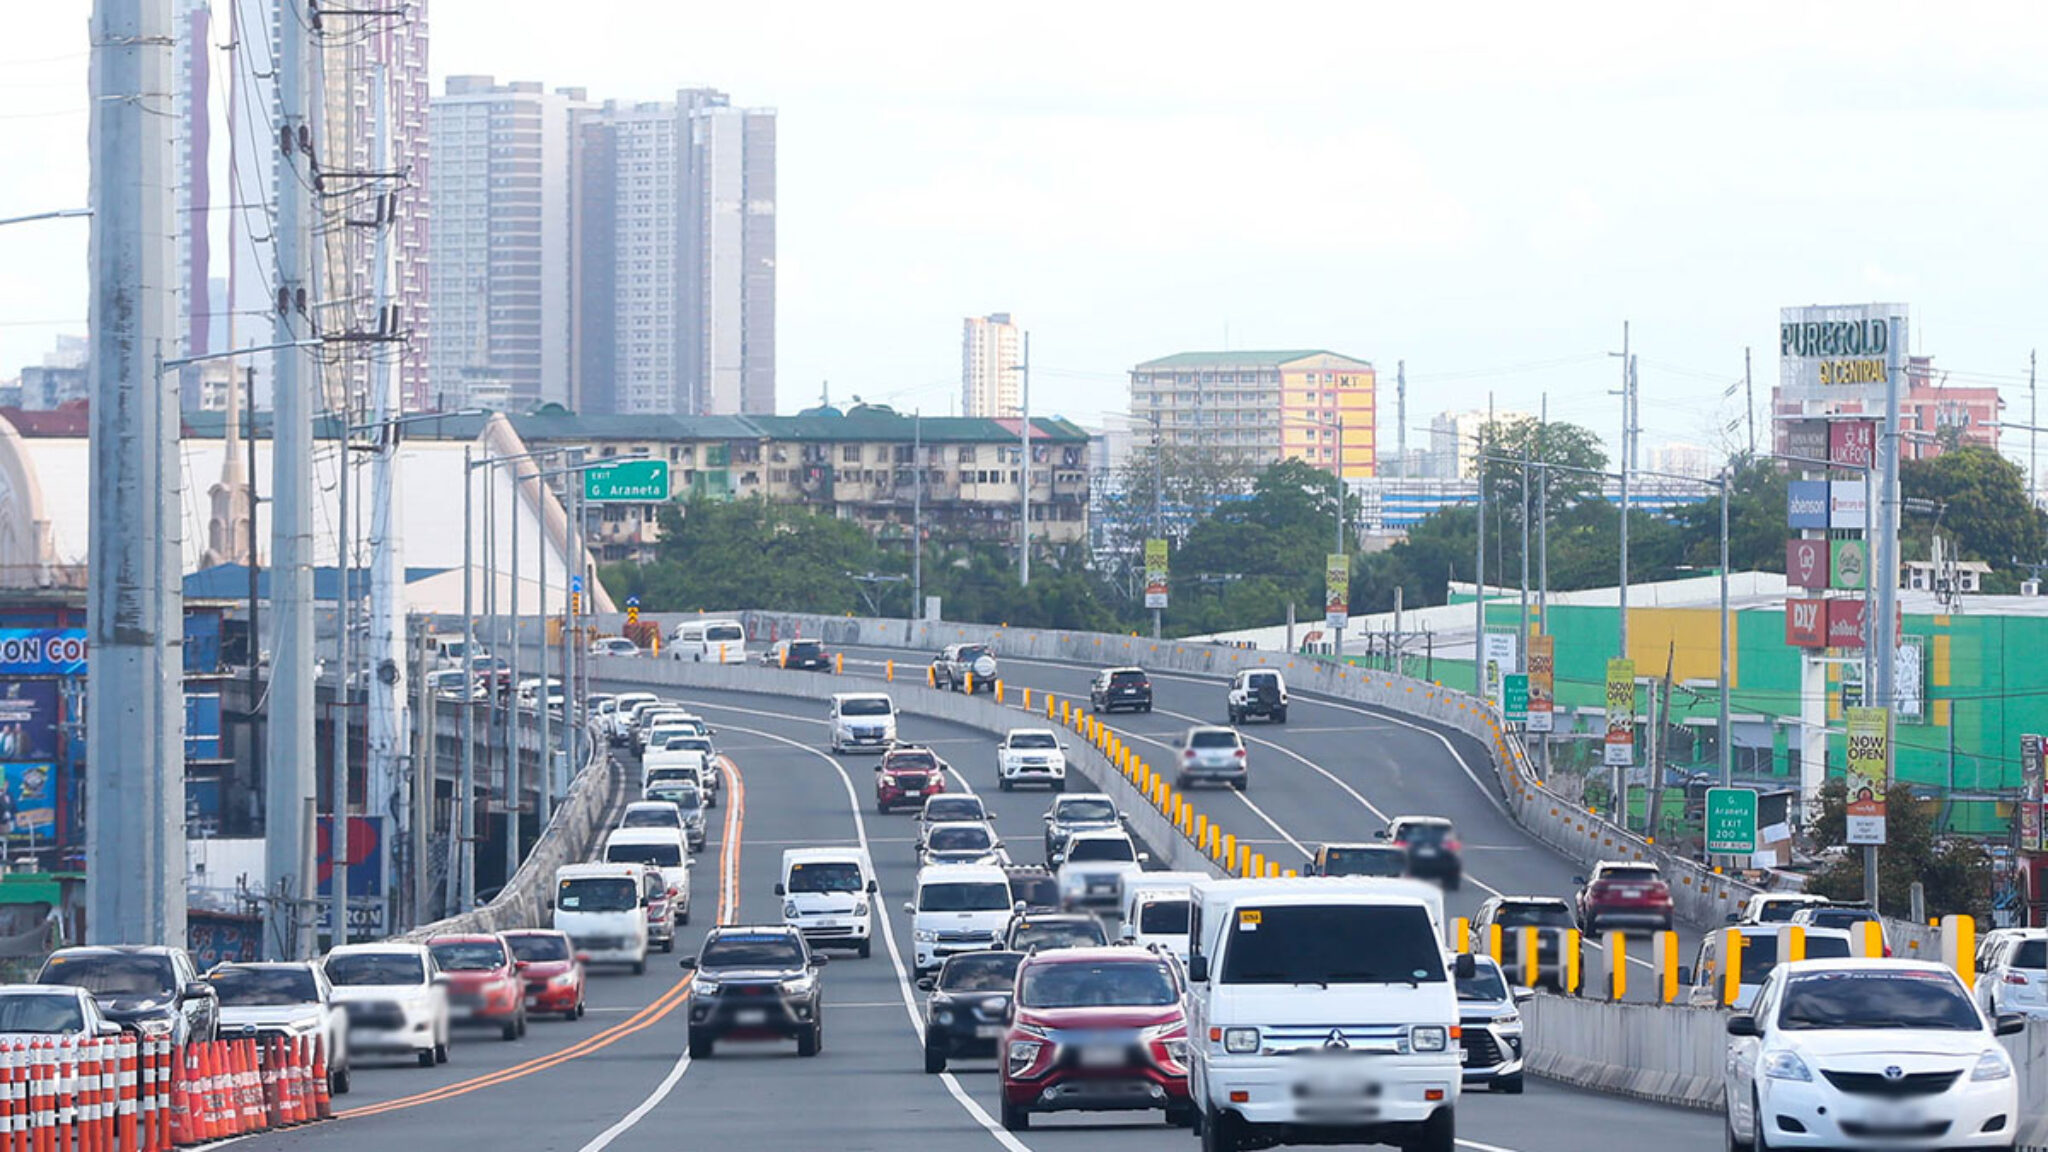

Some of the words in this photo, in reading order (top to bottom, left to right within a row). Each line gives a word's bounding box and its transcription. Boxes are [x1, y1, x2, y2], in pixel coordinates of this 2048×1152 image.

[1781, 319, 1888, 357] PUREGOLD
[1836, 359, 1888, 384] CENTRAL
[1831, 447, 1850, 463] LUK
[592, 471, 610, 480] EXIT
[592, 484, 604, 496] G.
[610, 485, 661, 496] Araneta
[1791, 495, 1825, 514] abenson
[1794, 603, 1818, 633] DIY
[0, 639, 40, 661] ON
[1609, 683, 1633, 691] NOW
[1608, 692, 1633, 700] OPEN
[1850, 736, 1884, 748] NOW
[1848, 748, 1884, 760] OPEN
[1715, 808, 1749, 816] Araneta
[1721, 820, 1742, 828] EXIT
[1716, 830, 1736, 838] 200
